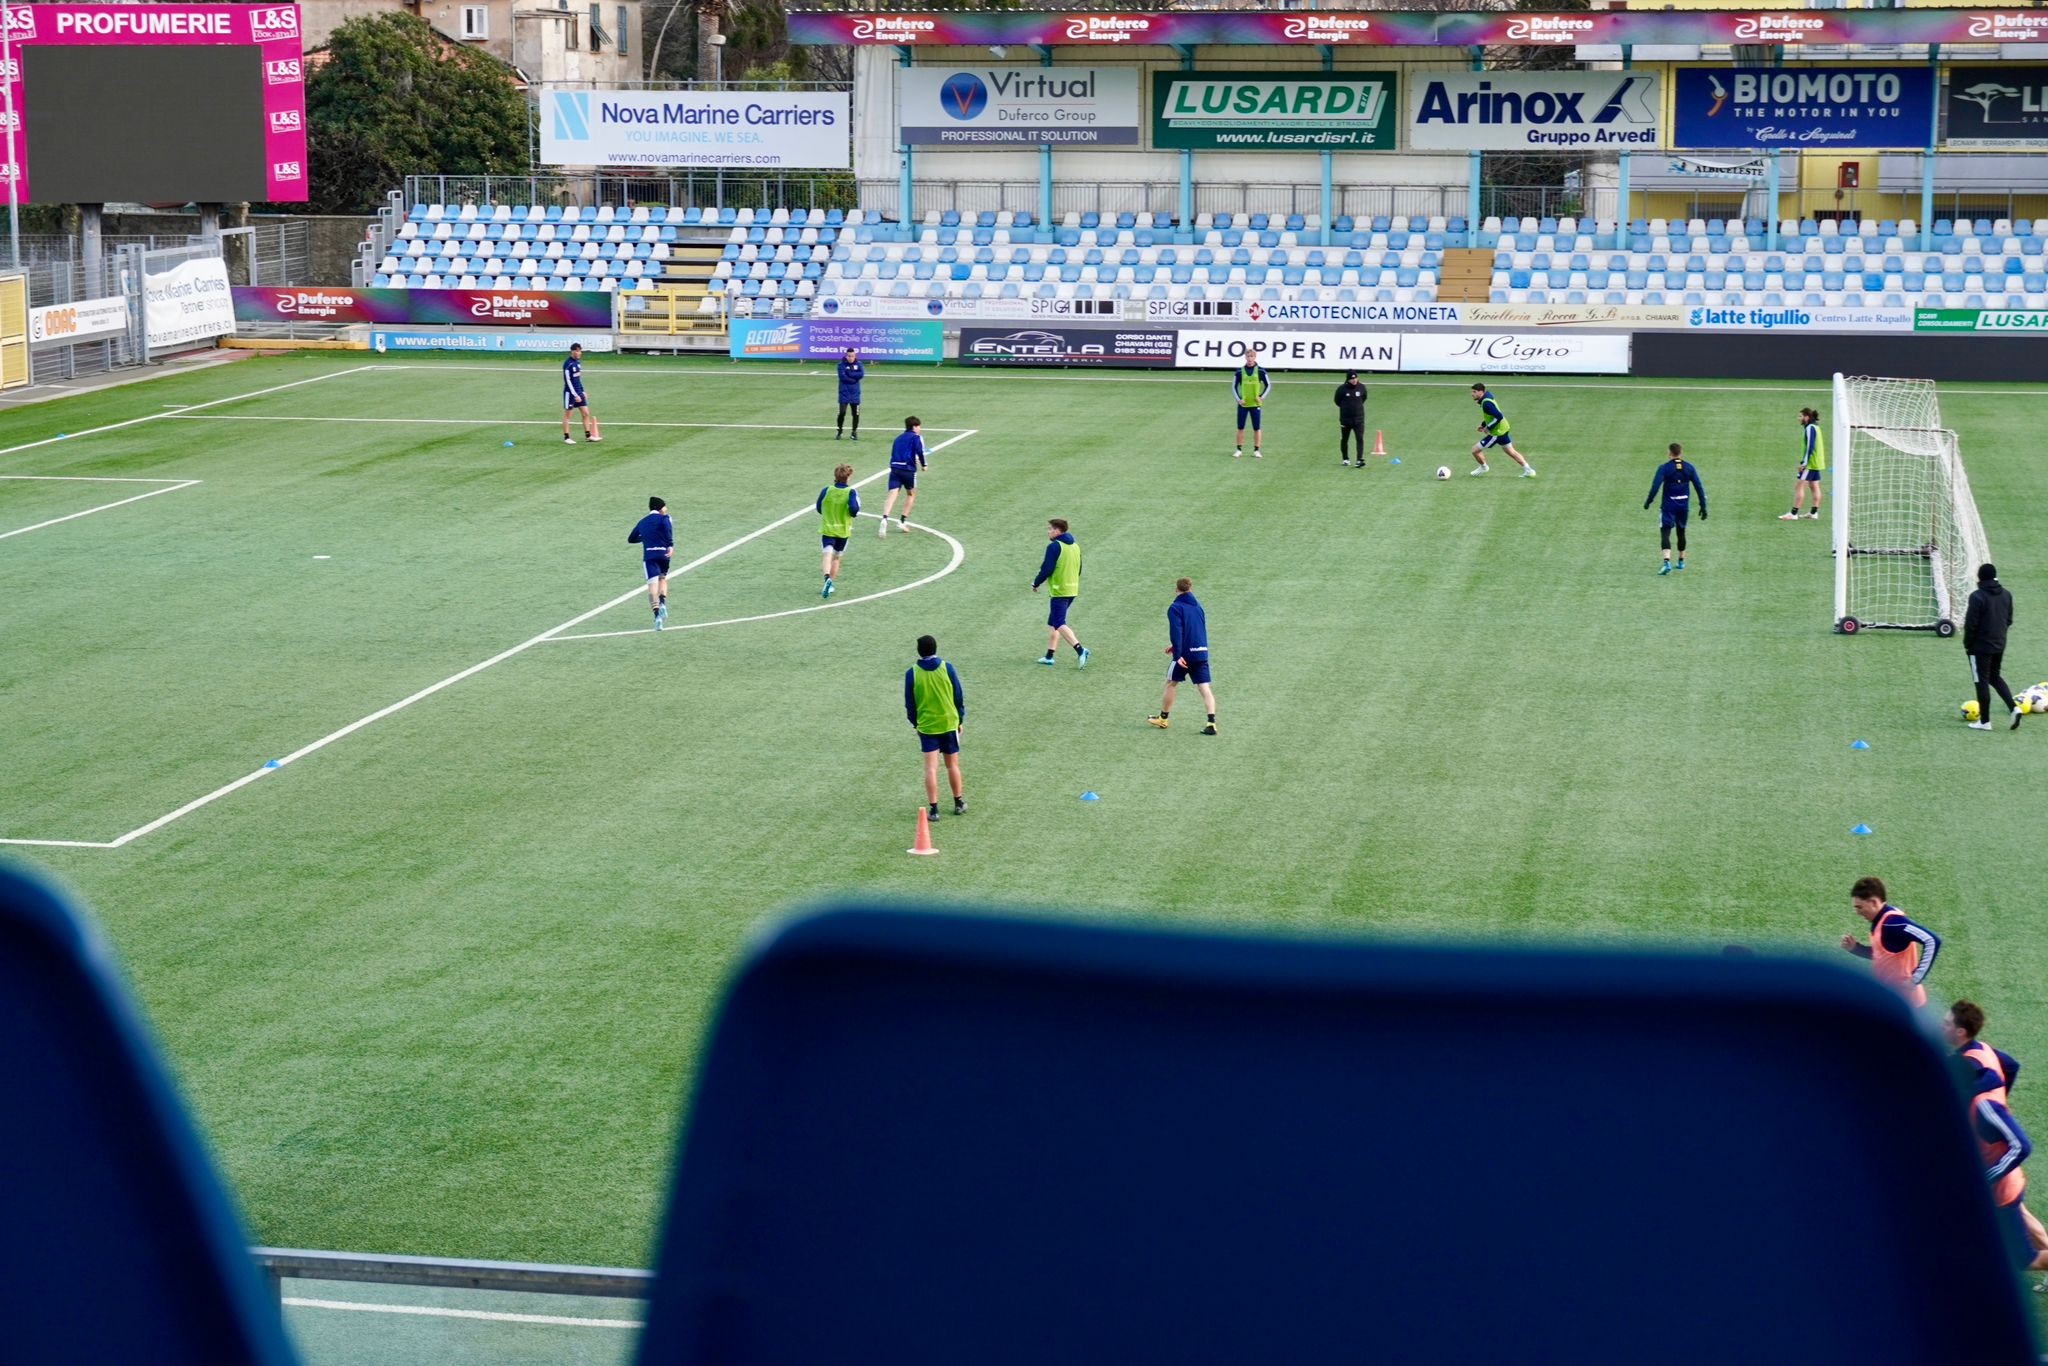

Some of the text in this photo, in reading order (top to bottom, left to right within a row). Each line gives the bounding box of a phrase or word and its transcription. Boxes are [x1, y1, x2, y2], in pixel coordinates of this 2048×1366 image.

[57, 13, 232, 34] PROFUMERIE
[252, 9, 297, 30] L&S
[876, 17, 934, 30] Duferco
[1089, 17, 1149, 30] Duferco
[1308, 17, 1369, 29] Duferco
[1531, 17, 1593, 29] Duferco
[1760, 16, 1824, 28] Duferco
[876, 31, 916, 42] Energia
[1089, 31, 1130, 42] Energia
[1308, 31, 1348, 42] Energia
[1531, 31, 1572, 42] Energia
[1760, 30, 1800, 41] Energia
[1993, 29, 2039, 40] Energia
[268, 61, 300, 76] L&S
[988, 70, 1095, 98] Virtual
[1733, 73, 1900, 104] BIOMOTO
[1174, 85, 1372, 114] LUSARDI
[1416, 81, 1586, 124] Arinox
[272, 112, 300, 125] L&S
[602, 102, 835, 126] Nova Marine Carriers
[998, 109, 1097, 123] Duferco Group
[1734, 108, 1900, 117] THE MOTOR IN YOU
[625, 130, 763, 144] YOU IMAGINE. WE SEA.
[941, 131, 1098, 141] PROFESSIONAL IT SOLUTION
[1216, 132, 1375, 144] www.lusardisrl.it
[1527, 128, 1656, 145] Gruppo Arvedi
[608, 152, 781, 164] www.novamarinecarriers.com
[276, 163, 299, 175] L&S
[298, 293, 353, 305] Duferco
[492, 295, 549, 308] Duferco
[838, 299, 872, 308] Virtual
[943, 299, 977, 309] Virtual
[298, 306, 336, 317] Energia
[1031, 300, 1070, 314] SPIGA
[1149, 301, 1189, 315] SPIGA
[1268, 304, 1458, 321] CARTOTECNICA MONETA
[493, 309, 532, 320] Energia
[1469, 307, 1531, 321] Gioielleria
[1537, 307, 1577, 321] Rocca
[1706, 309, 1912, 328] latte tigullio Centro Latte Rapallo
[45, 308, 77, 336] ODAC
[809, 326, 833, 335] Prova
[834, 326, 839, 335] il
[856, 327, 886, 337] sharing
[888, 327, 921, 336] elettrico
[395, 335, 487, 347] www.entella.it
[816, 335, 860, 343] sostenibile
[862, 335, 869, 343] di
[1154, 341, 1173, 349] (GE)
[809, 346, 839, 354] Scarica
[861, 346, 887, 354] Elettra
[895, 347, 934, 356] registrati!
[973, 343, 1105, 355] ENTELLA
[1184, 339, 1393, 361] CHOPPER MAN
[1486, 335, 1570, 361] Cigno
[1480, 363, 1546, 373] Cavi di Lavagna
